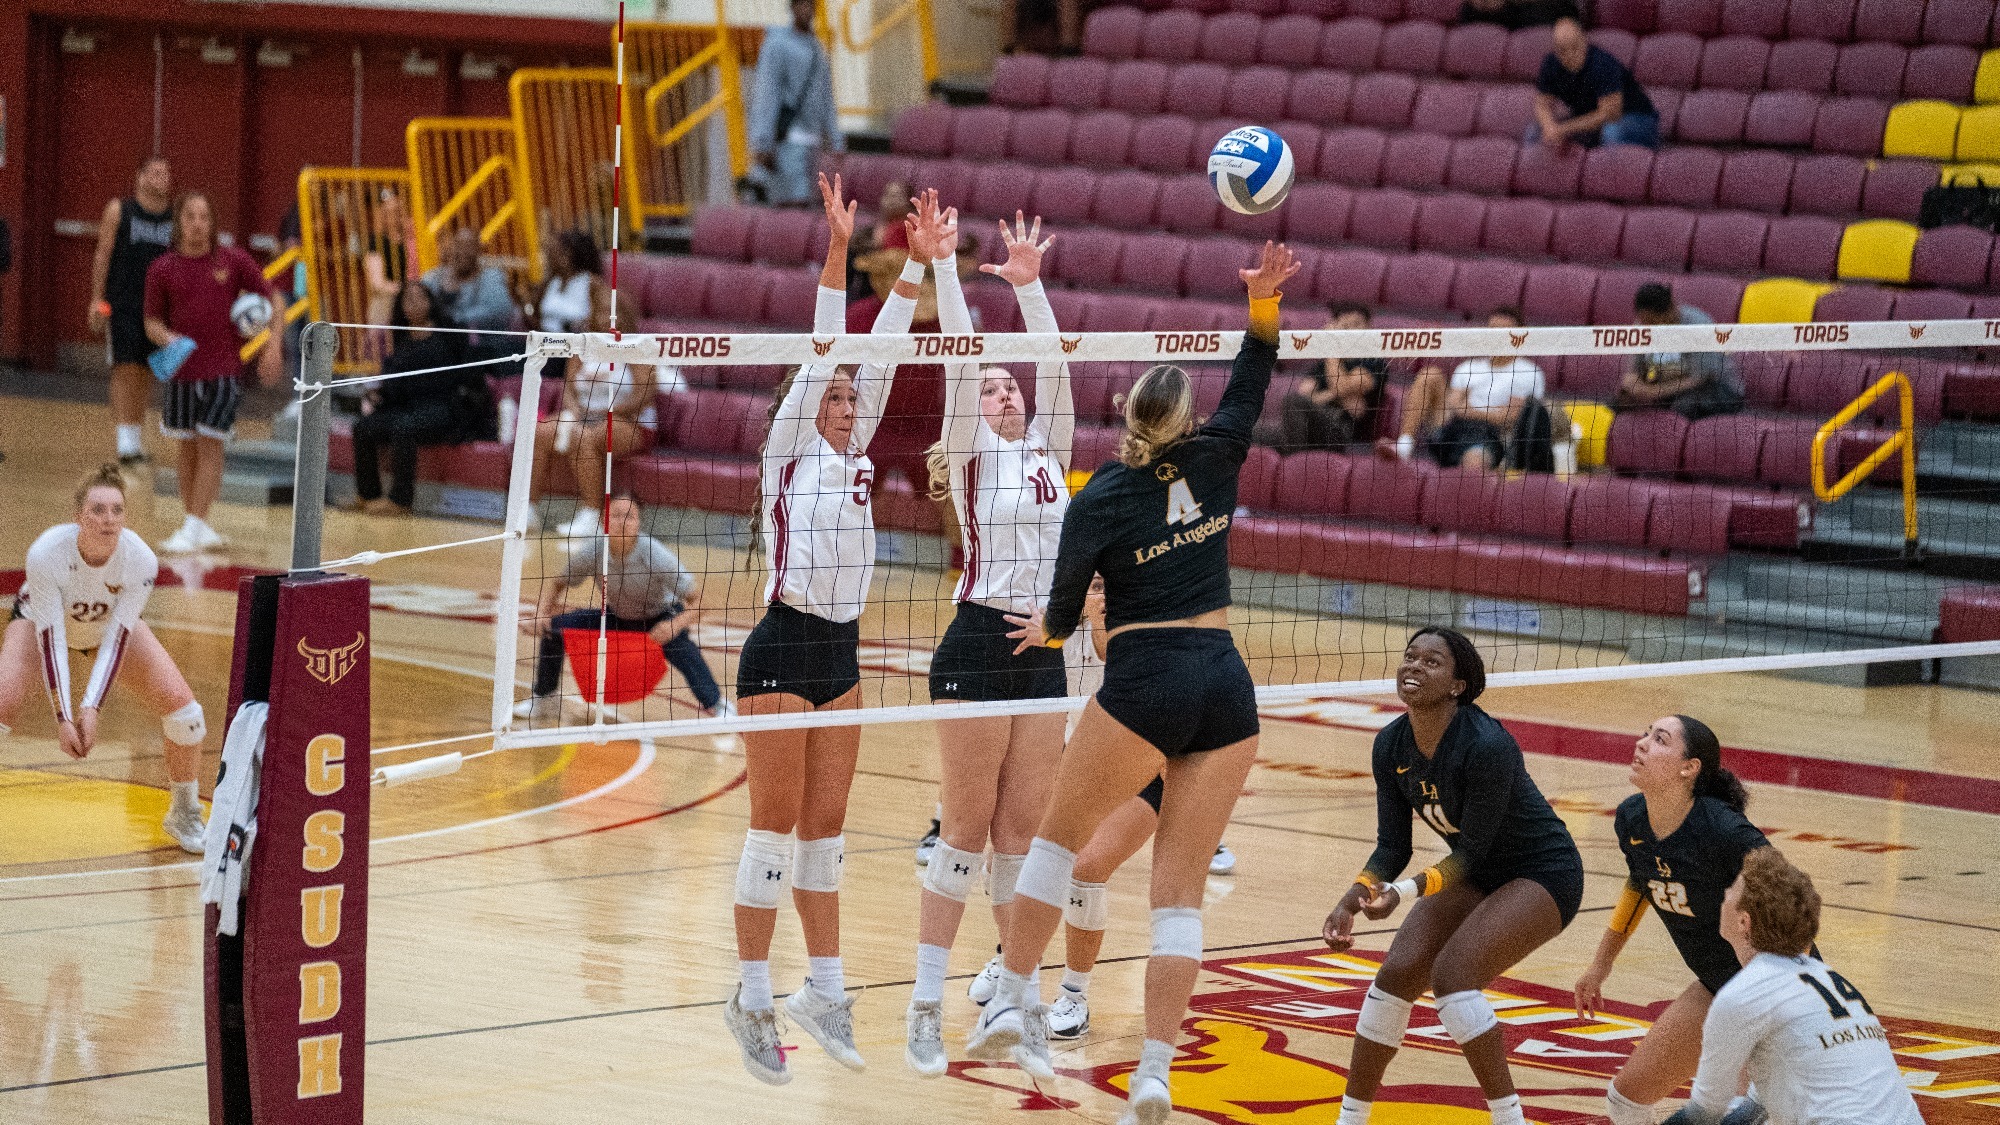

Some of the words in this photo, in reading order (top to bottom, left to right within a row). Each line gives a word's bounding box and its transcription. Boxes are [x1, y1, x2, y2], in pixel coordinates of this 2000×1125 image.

[655, 336, 731, 358] TOROS
[913, 335, 984, 357] TOROS
[1153, 333, 1221, 354] TOROS
[1379, 331, 1443, 351] TOROS
[1592, 328, 1652, 348] TOROS
[1793, 324, 1850, 344] TOROS
[853, 468, 872, 507] 5
[1027, 466, 1058, 505] 10
[1166, 477, 1203, 526] 4
[1134, 540, 1172, 566] Los
[1173, 514, 1229, 548] Angeles
[71, 601, 109, 623] 22
[297, 732, 346, 1101] CSUDH
[1647, 879, 1697, 918] 22
[1798, 969, 1875, 1020] 14
